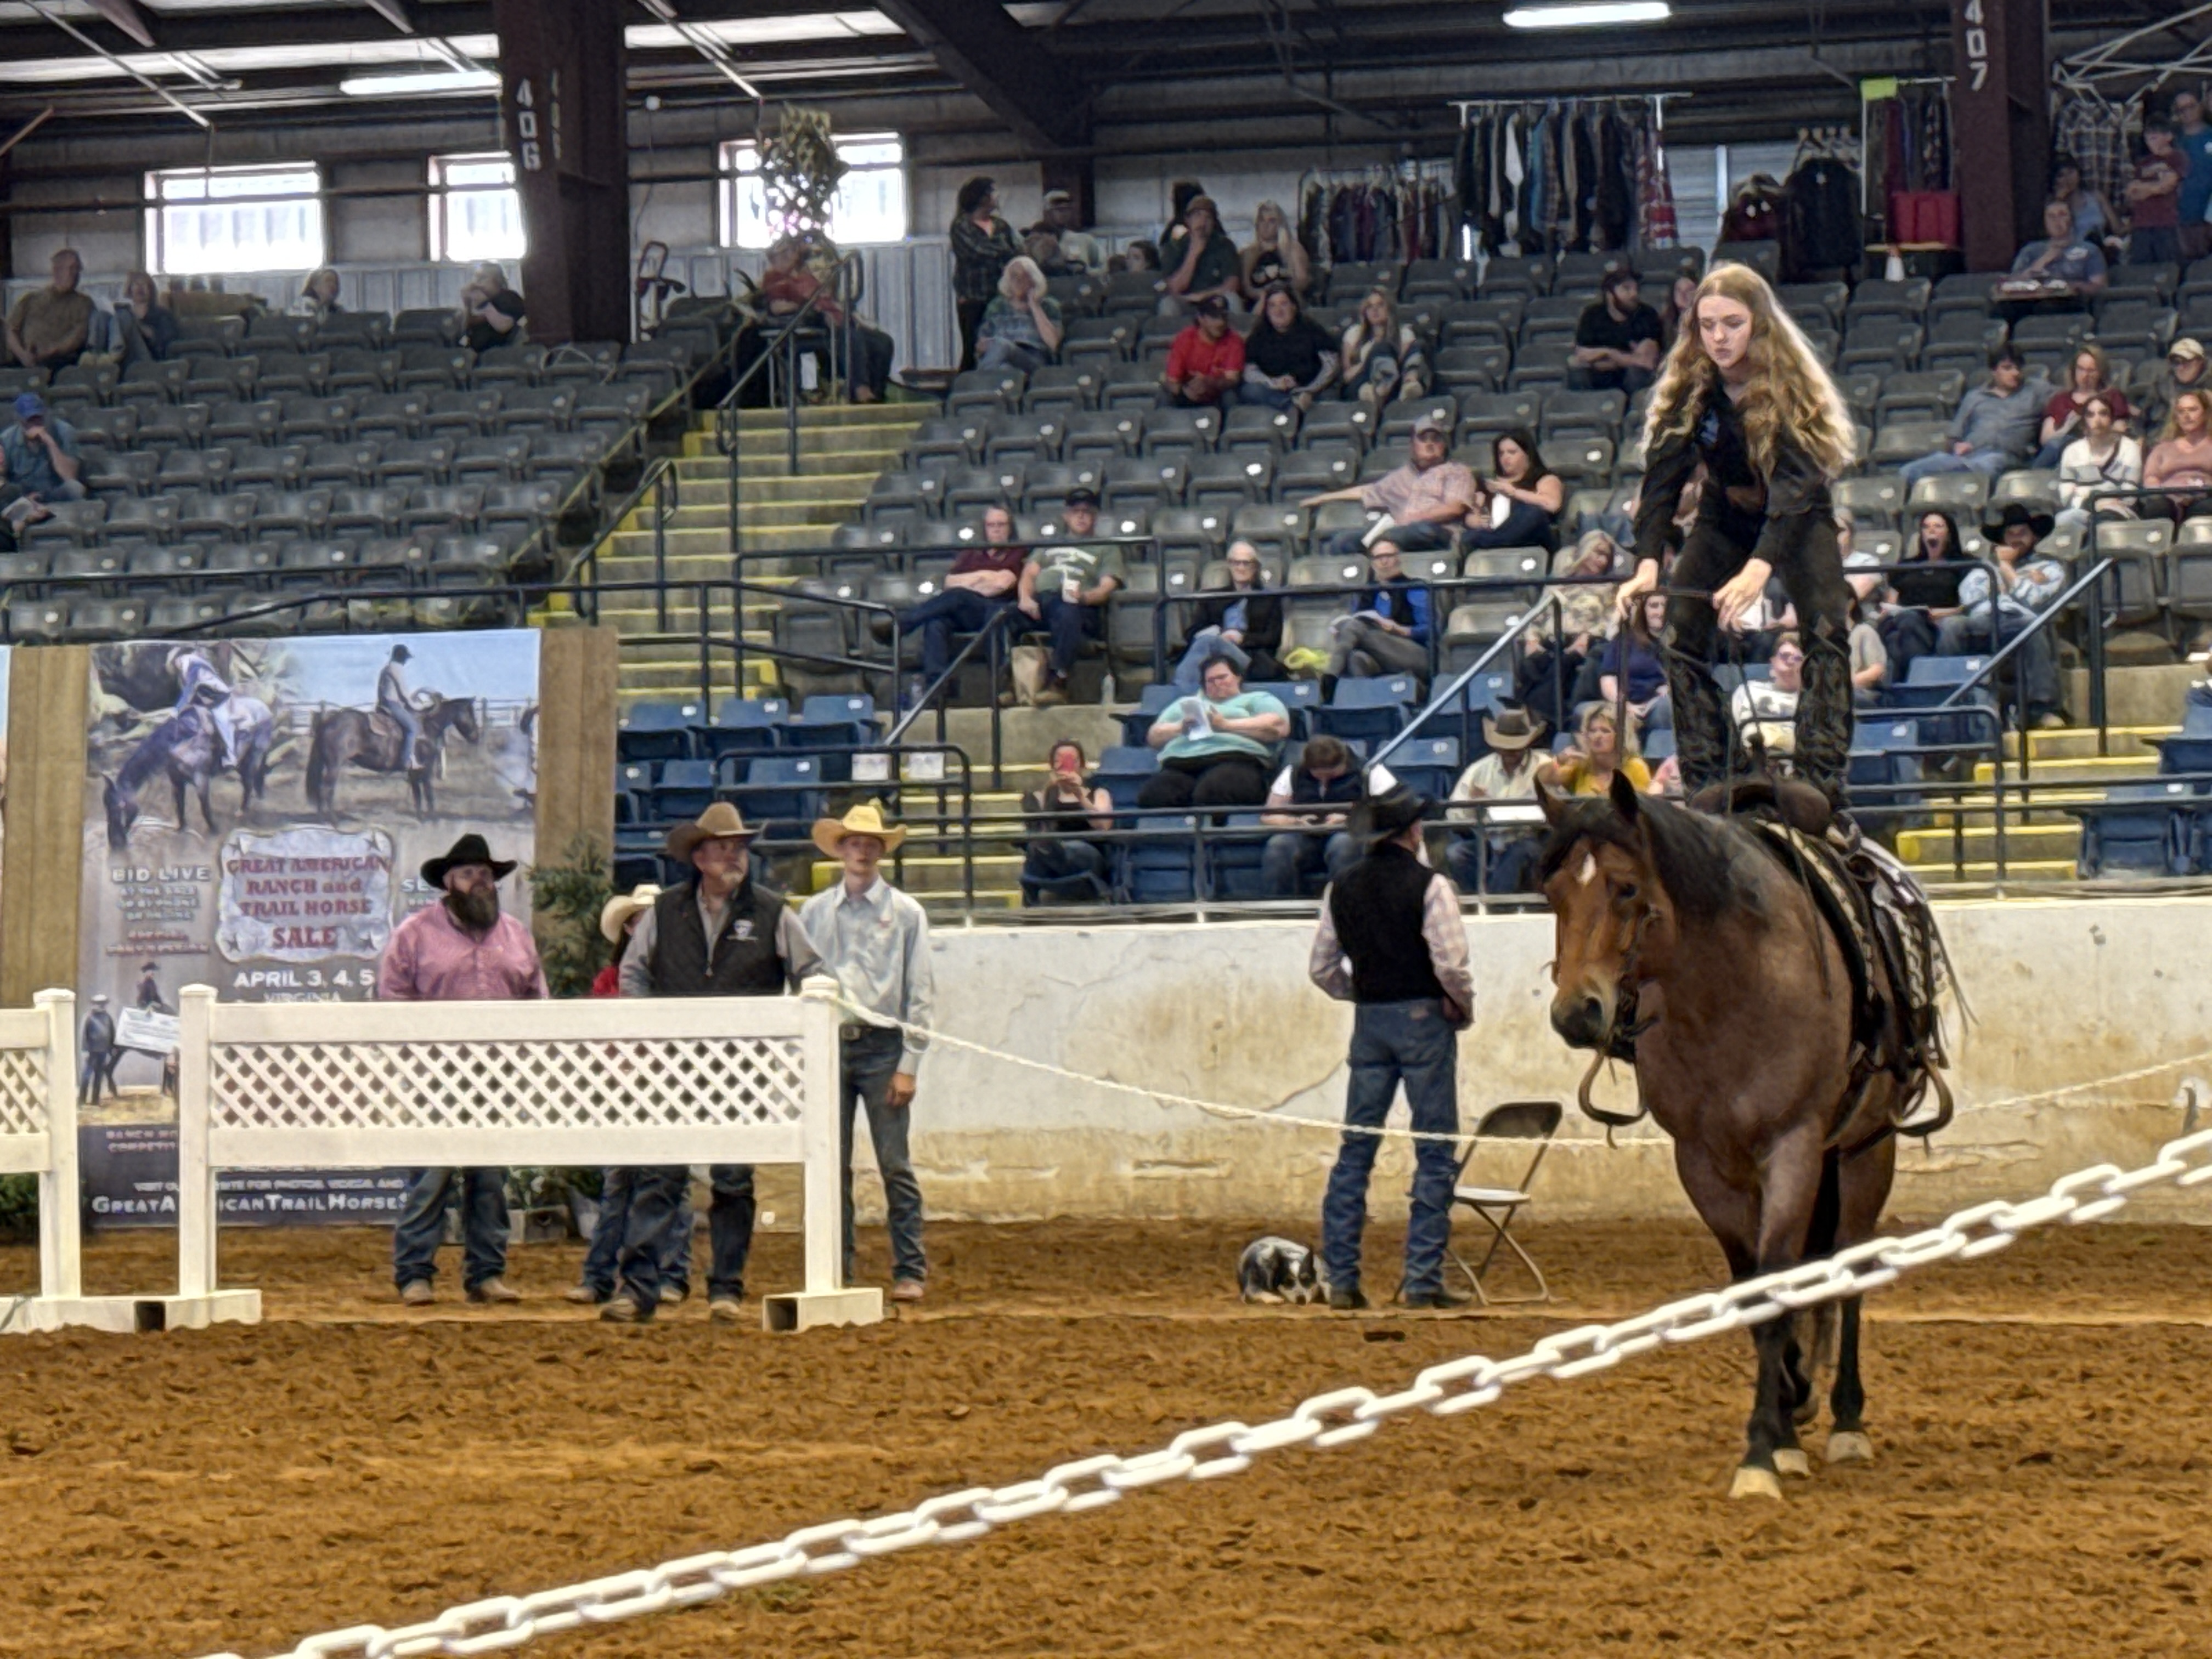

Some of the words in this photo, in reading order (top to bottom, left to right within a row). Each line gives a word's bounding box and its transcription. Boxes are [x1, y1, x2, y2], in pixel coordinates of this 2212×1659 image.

[1964, 0, 1989, 92] 407
[516, 77, 542, 172] 406
[112, 867, 150, 882] BID
[157, 866, 210, 881] LIVE
[226, 859, 286, 875] GREAT
[246, 878, 317, 895] RANCH
[322, 878, 362, 893] and
[238, 900, 300, 917] TRAIL
[304, 899, 373, 915] HORSE
[272, 926, 338, 949] SALE
[234, 970, 303, 988] APRIL
